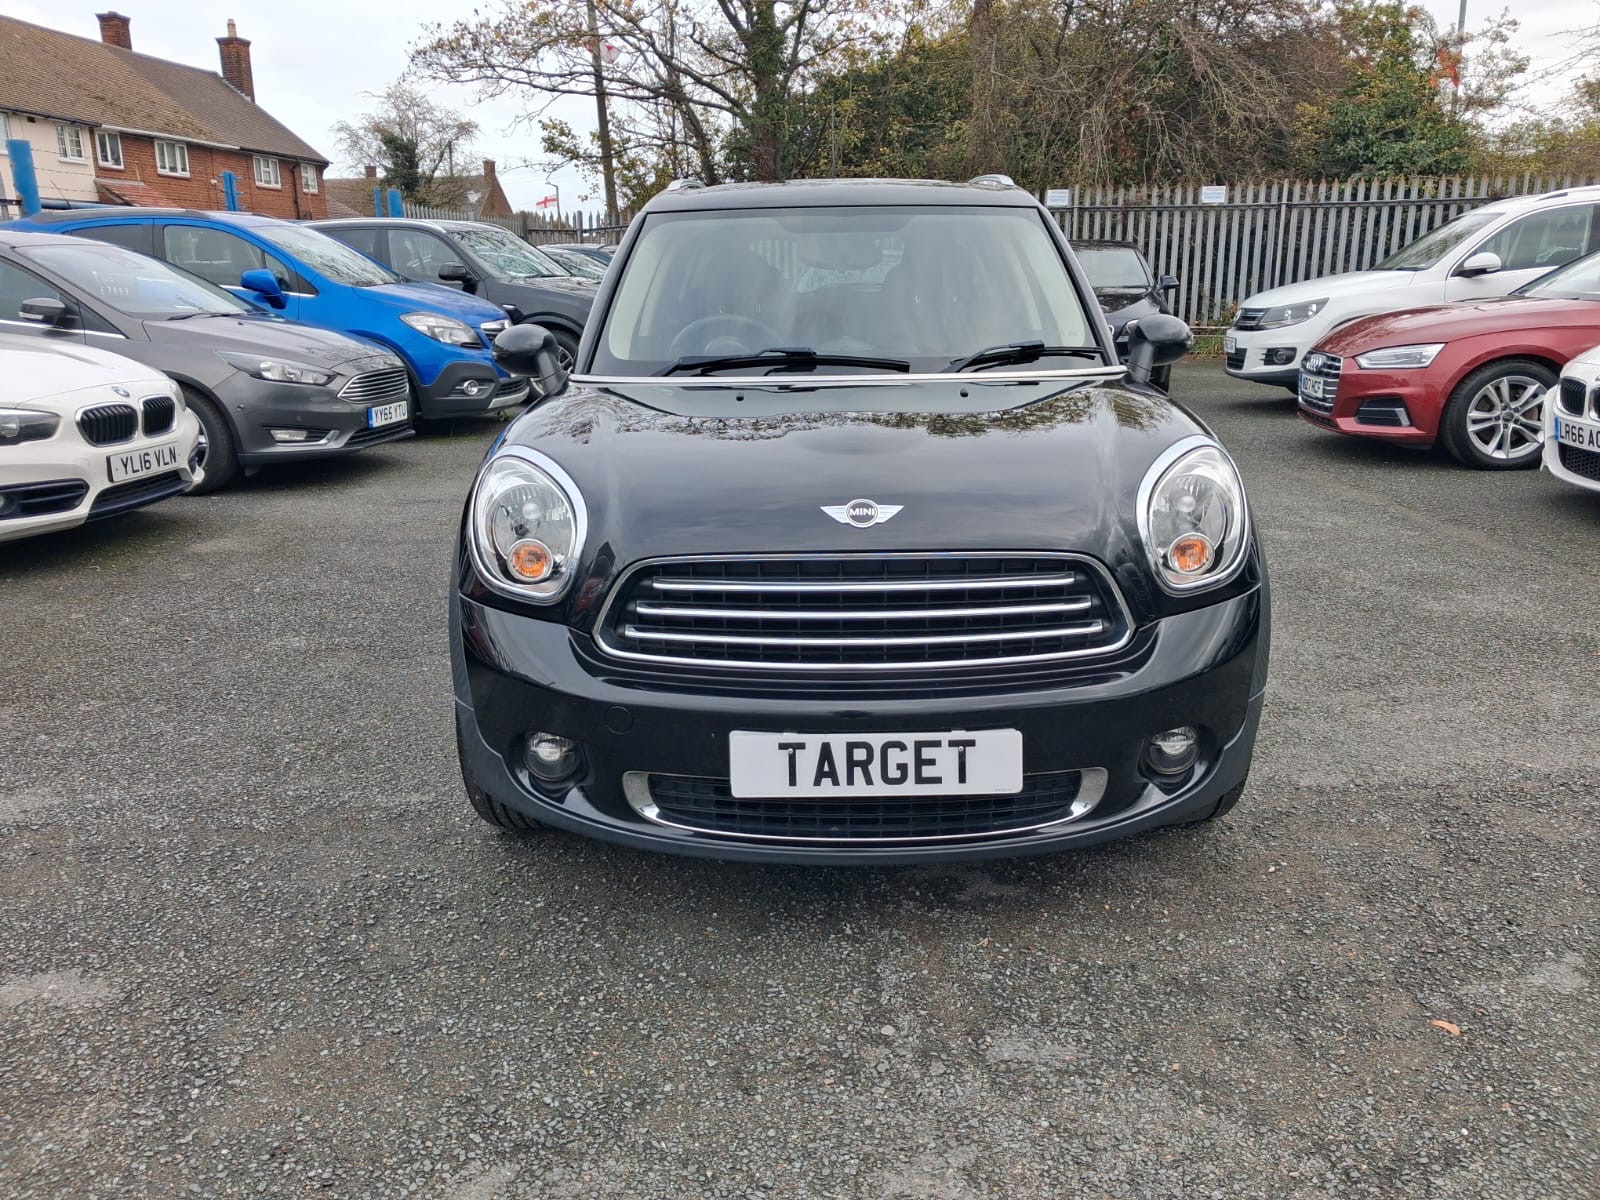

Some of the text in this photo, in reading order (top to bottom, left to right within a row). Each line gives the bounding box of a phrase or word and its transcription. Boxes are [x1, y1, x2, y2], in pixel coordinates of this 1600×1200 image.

[374, 403, 407, 422] YY65 YTU
[1560, 420, 1584, 444] LR66
[120, 446, 177, 475] YL16 VLN
[849, 507, 875, 516] MINI
[778, 739, 976, 787] TARGET
